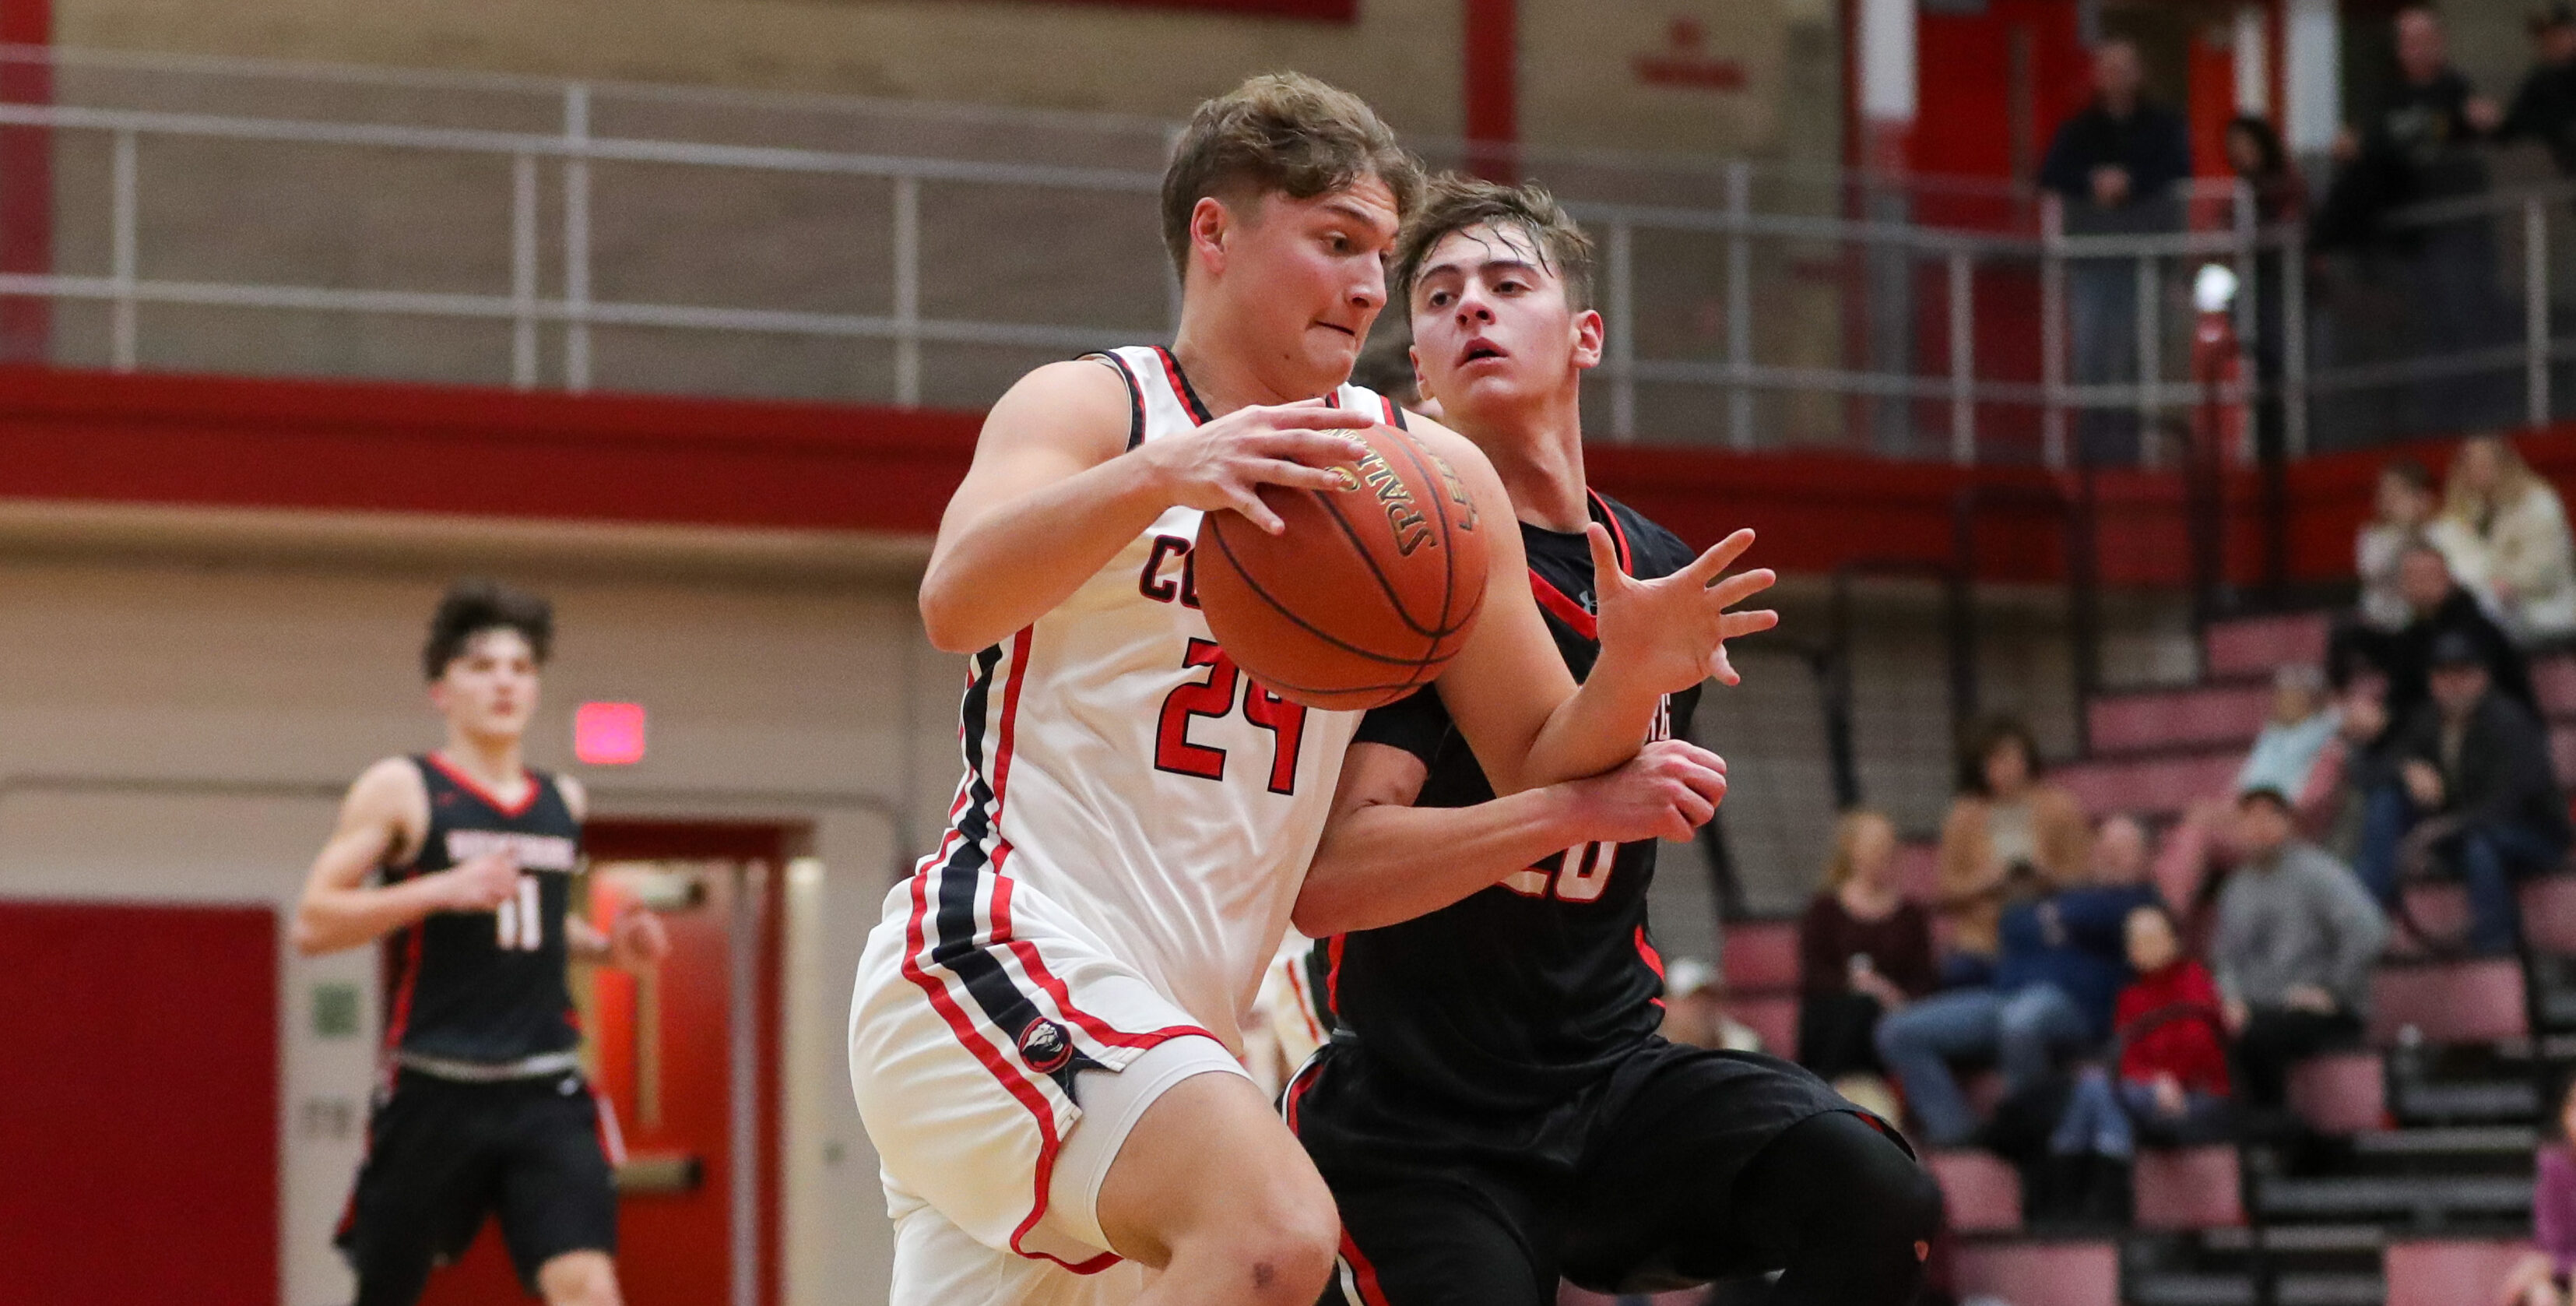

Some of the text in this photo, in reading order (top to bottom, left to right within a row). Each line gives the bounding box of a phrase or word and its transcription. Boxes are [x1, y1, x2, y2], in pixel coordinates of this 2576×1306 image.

[1320, 428, 1438, 558] SPAL
[1154, 637, 1308, 796] 24
[497, 875, 543, 950] 11
